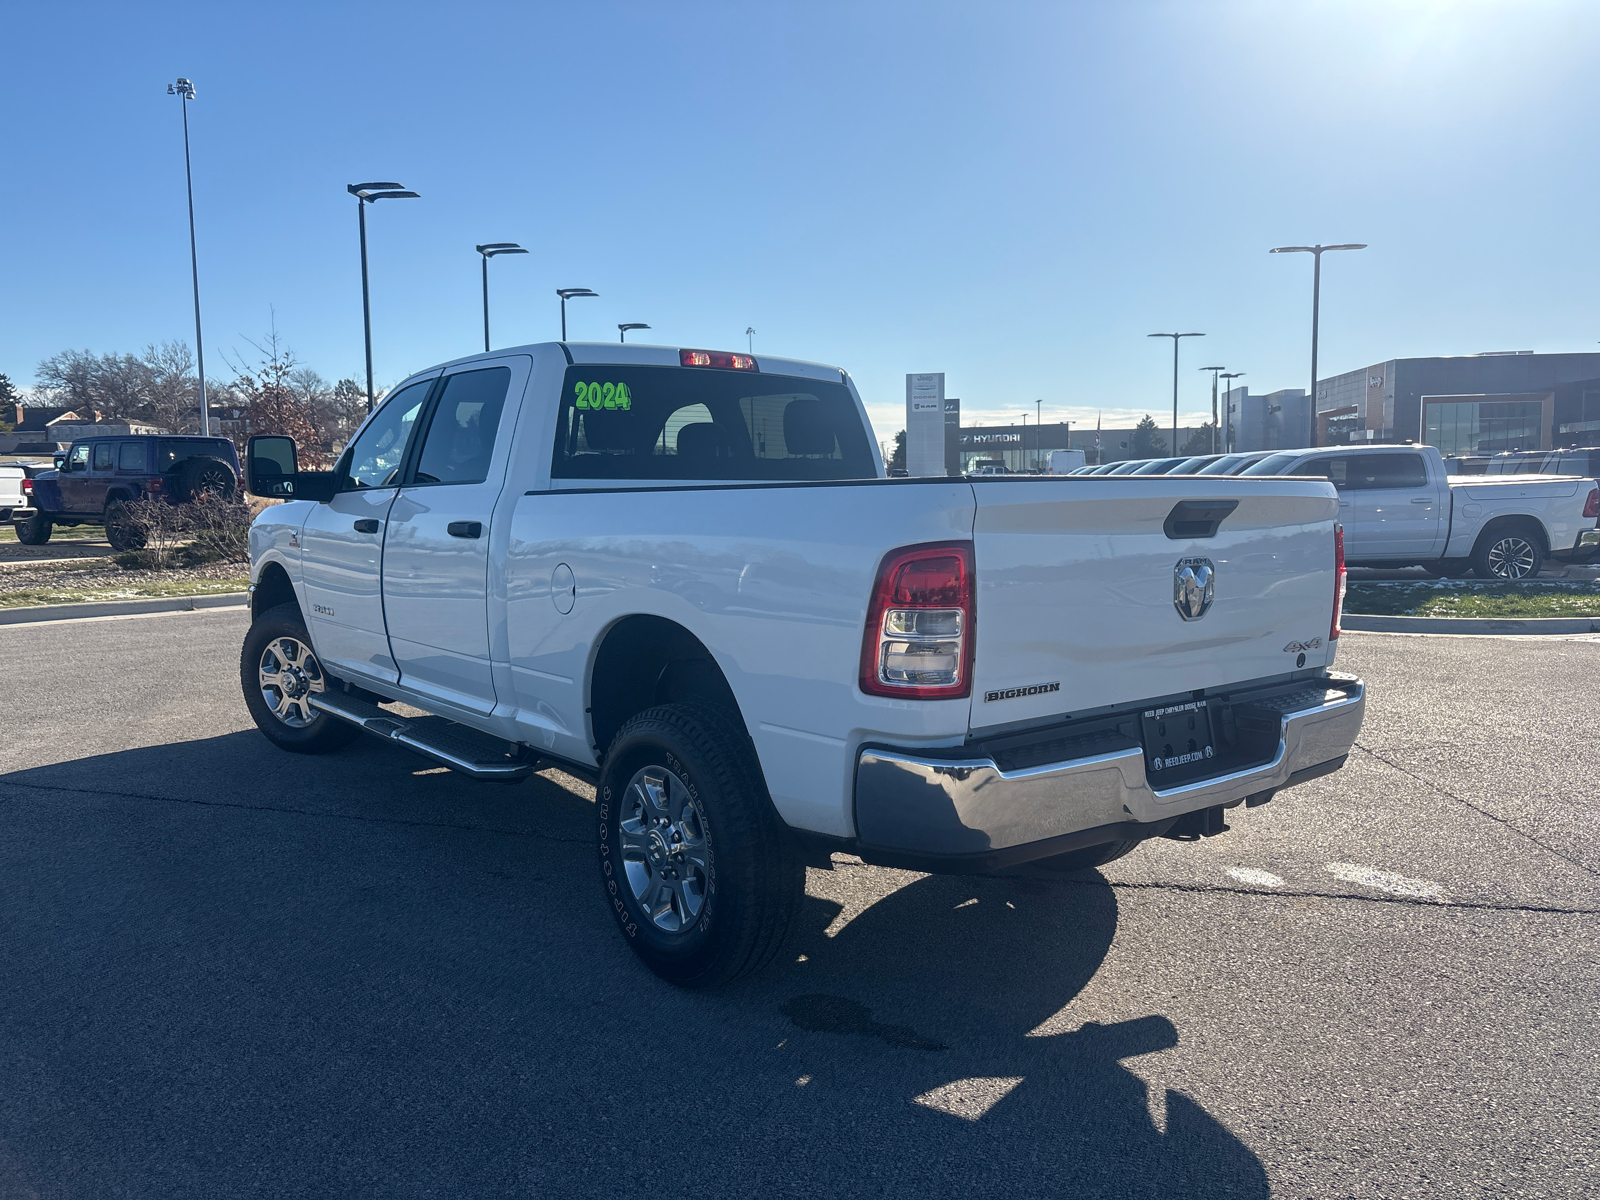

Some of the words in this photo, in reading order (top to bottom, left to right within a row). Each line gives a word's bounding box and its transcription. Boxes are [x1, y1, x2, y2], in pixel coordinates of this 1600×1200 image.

[574, 381, 632, 411] 2024
[973, 433, 1020, 443] HYUNDAI
[1184, 557, 1207, 565] RAM
[984, 681, 1061, 703] BIGHORN
[1144, 710, 1155, 718] REED
[1155, 708, 1164, 716] JEEP
[1165, 704, 1184, 714] CHRYSLER
[1185, 702, 1196, 710] DODGE
[1197, 700, 1207, 708] RAM
[1164, 751, 1203, 768] REEDJEEP.COM
